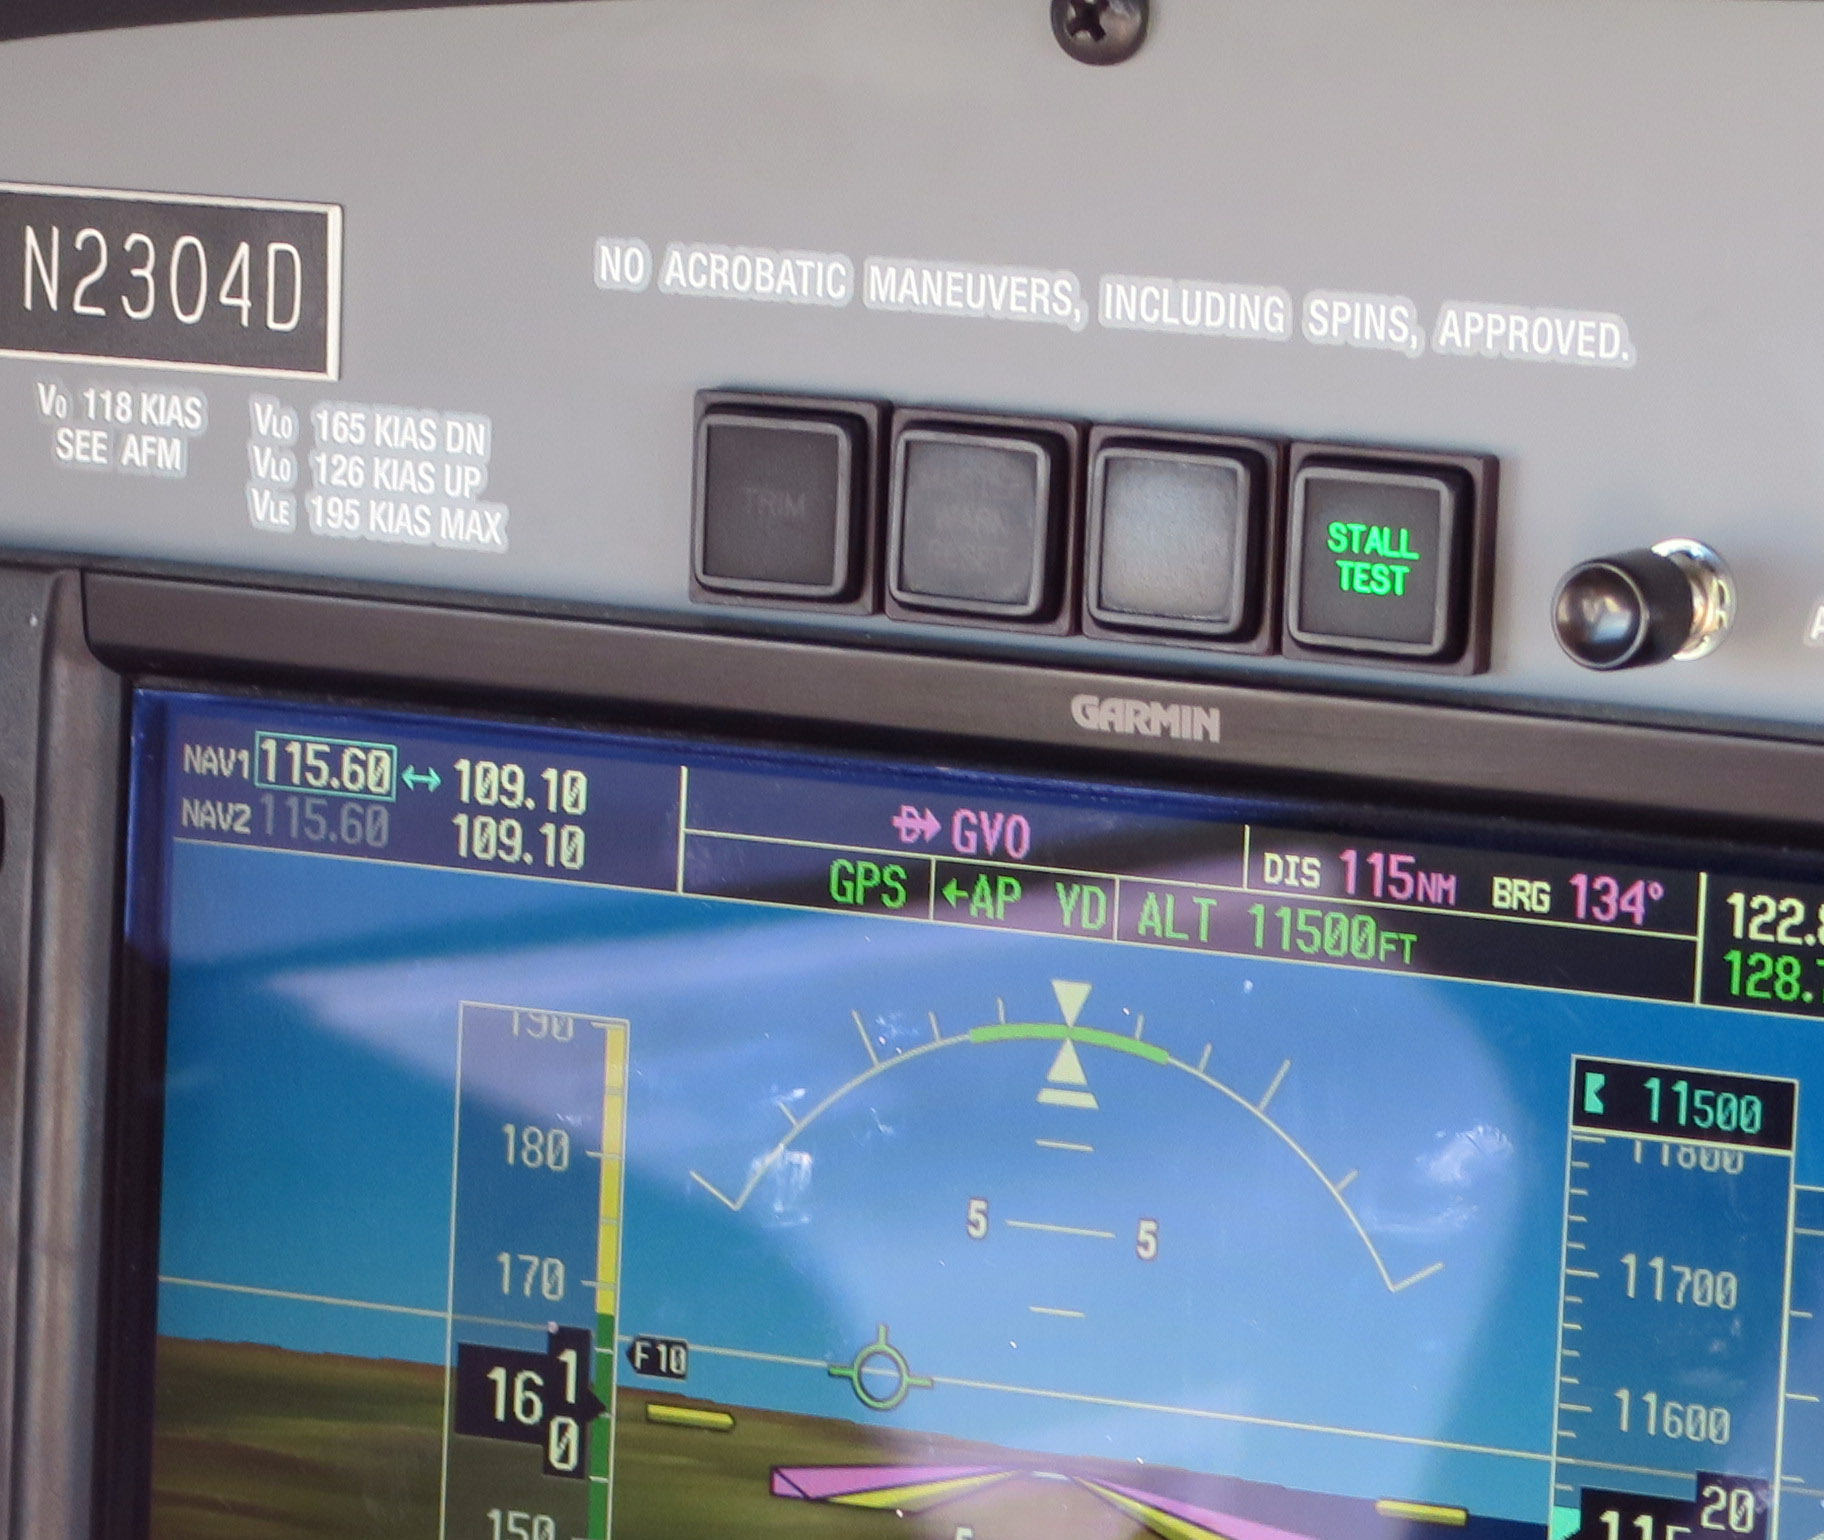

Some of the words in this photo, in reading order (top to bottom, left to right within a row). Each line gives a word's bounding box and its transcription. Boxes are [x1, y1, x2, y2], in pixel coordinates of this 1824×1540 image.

[23, 225, 303, 331] N2304D
[599, 244, 645, 286] NO
[664, 252, 847, 300] ACROBATIC
[868, 265, 1083, 324] MANEUVERS,
[1104, 283, 1286, 333] INCLUDING
[1309, 300, 1421, 351] SPINS,
[1438, 311, 1631, 362] APPROVED.
[83, 389, 133, 425] 118
[140, 394, 203, 429] KIAS
[316, 410, 365, 446] 165
[374, 415, 436, 451] KIAS
[445, 420, 485, 456] DN
[56, 429, 107, 465] SEE
[121, 435, 182, 470] AFM
[315, 453, 364, 488] 126
[373, 458, 435, 494] KIAS
[444, 462, 482, 497] UP
[310, 496, 360, 532] 195
[369, 501, 432, 537] KIAS
[439, 506, 503, 544] MAX
[1327, 520, 1420, 562] STALL
[1336, 560, 1409, 597] TEST
[1071, 695, 1221, 743] GARMIN
[183, 744, 250, 780] NAV1
[260, 738, 392, 794] 115.60
[454, 759, 587, 816] 109.10
[182, 797, 251, 836] NAV2
[452, 812, 585, 870] 109.10
[829, 859, 907, 909] GPS
[1139, 891, 1218, 944] ALT
[1264, 853, 1322, 889] DIS
[1492, 877, 1551, 914] BRG
[1644, 1077, 1763, 1135] 11500
